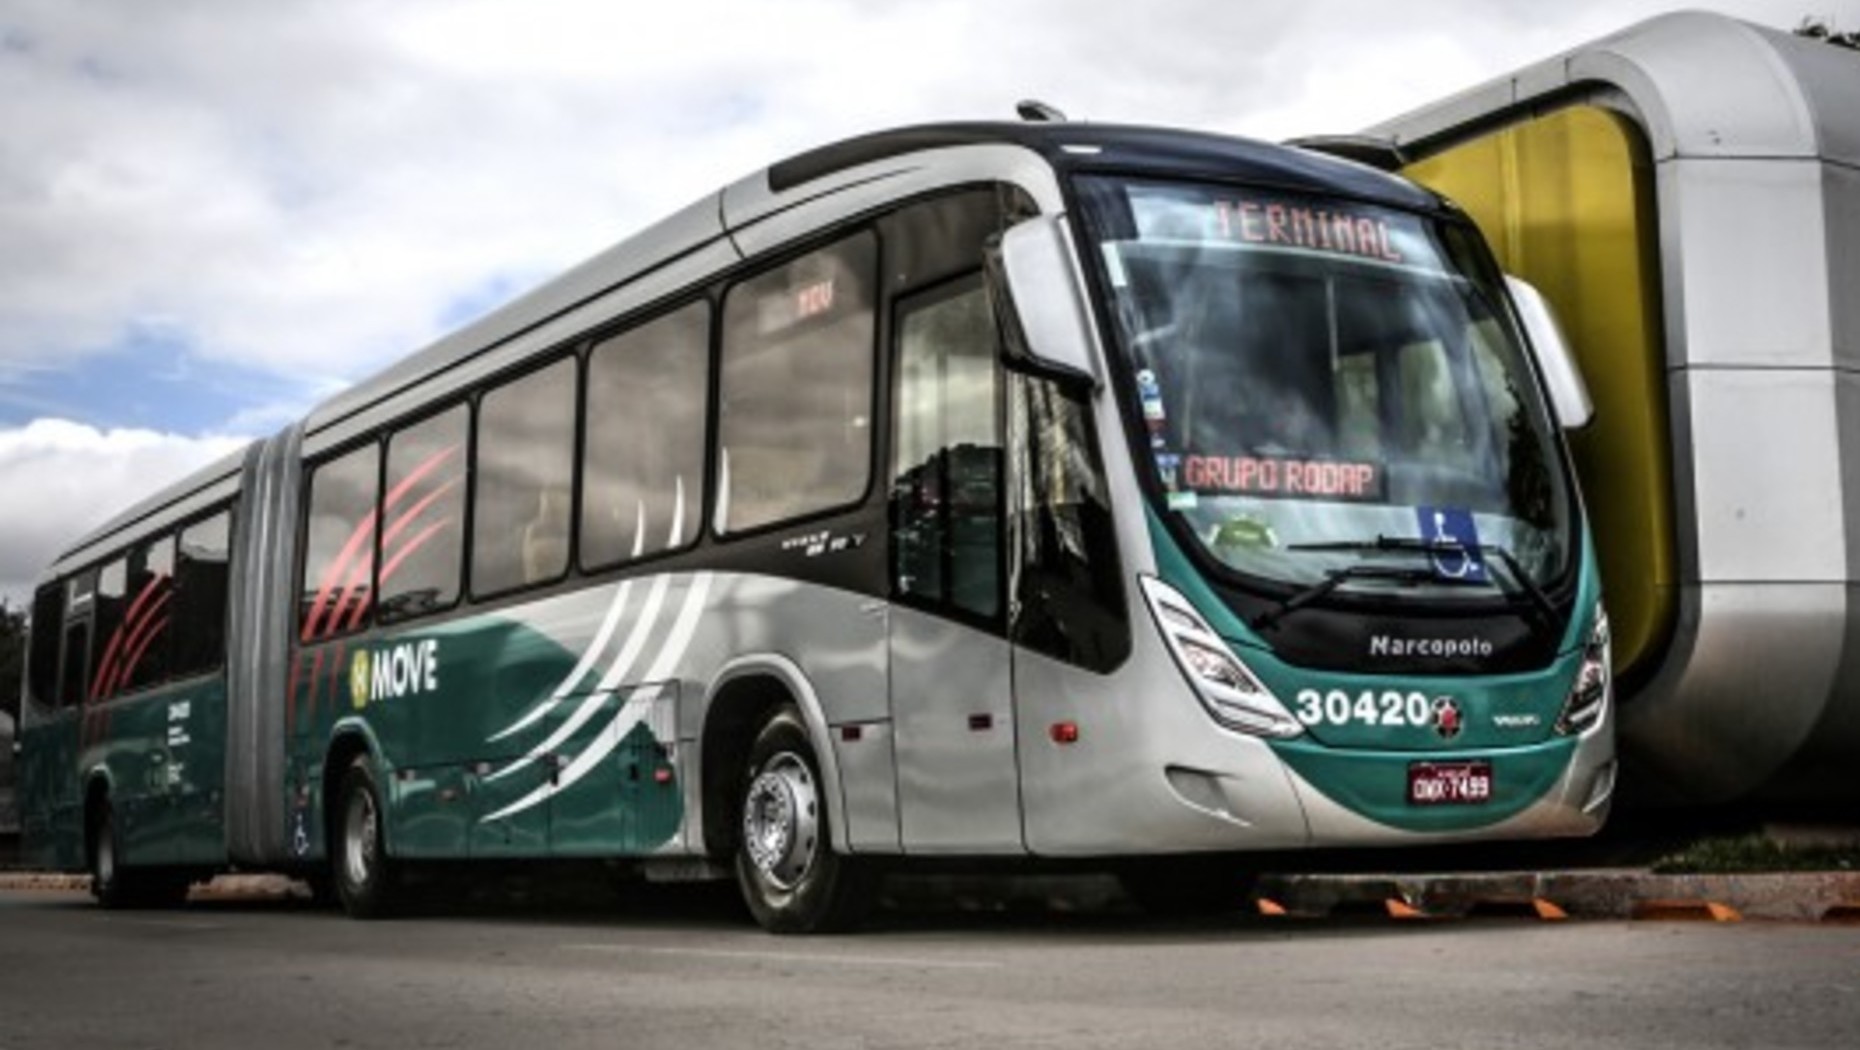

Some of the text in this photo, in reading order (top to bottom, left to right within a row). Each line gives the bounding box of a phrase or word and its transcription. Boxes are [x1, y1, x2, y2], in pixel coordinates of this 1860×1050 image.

[1213, 200, 1400, 262] TERMINAL
[1185, 455, 1373, 495] GRUPO RODAP
[1369, 635, 1493, 657] Marcopolo
[371, 638, 438, 702] MOVE
[1297, 688, 1430, 726] 30420
